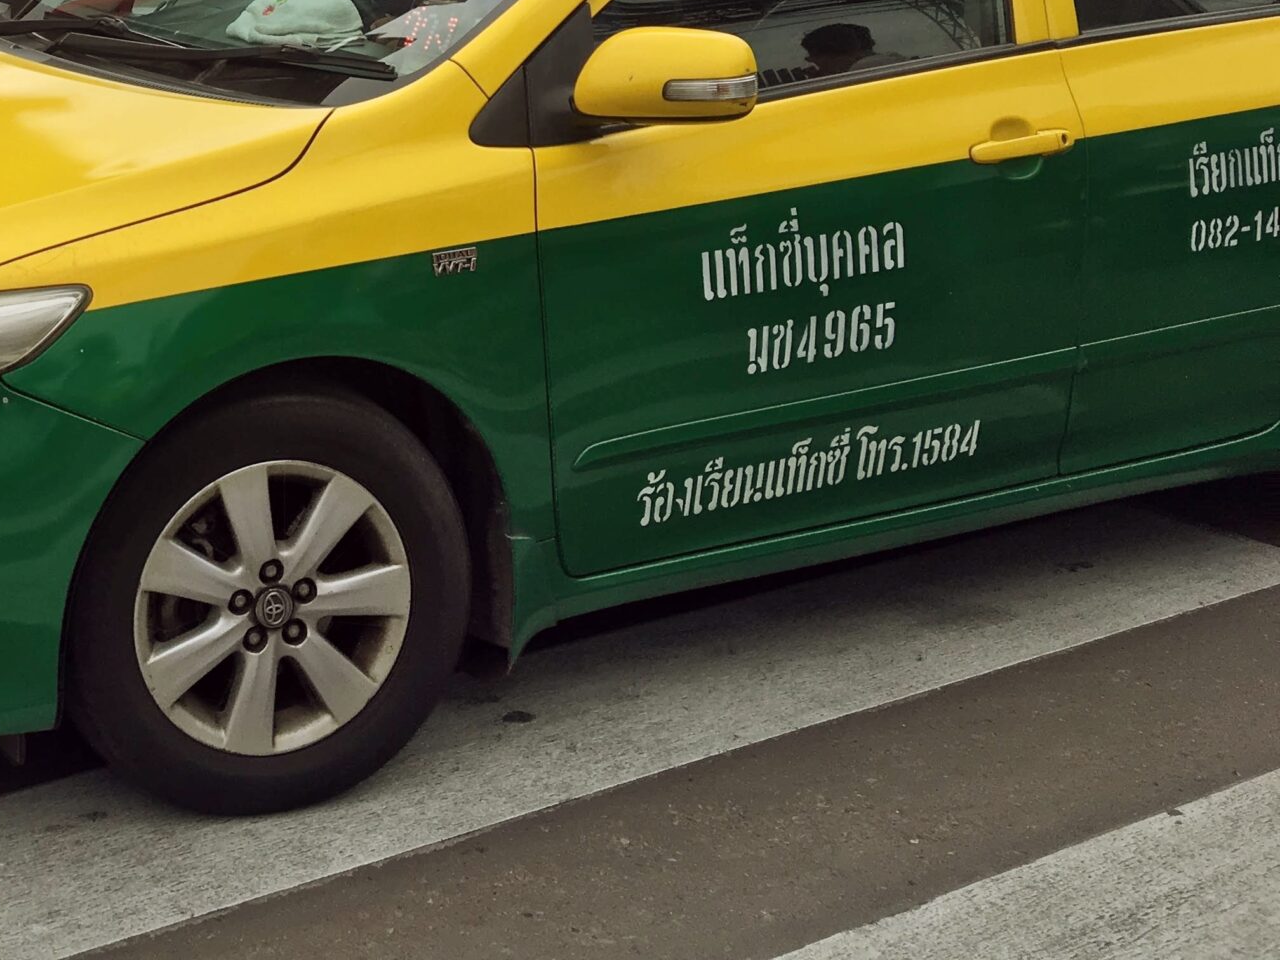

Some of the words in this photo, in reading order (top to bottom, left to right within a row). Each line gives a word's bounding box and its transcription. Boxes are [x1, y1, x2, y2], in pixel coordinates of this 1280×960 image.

[1188, 127, 1280, 198] เรียกแท็
[701, 207, 906, 301] แท็กซี่บุคคล
